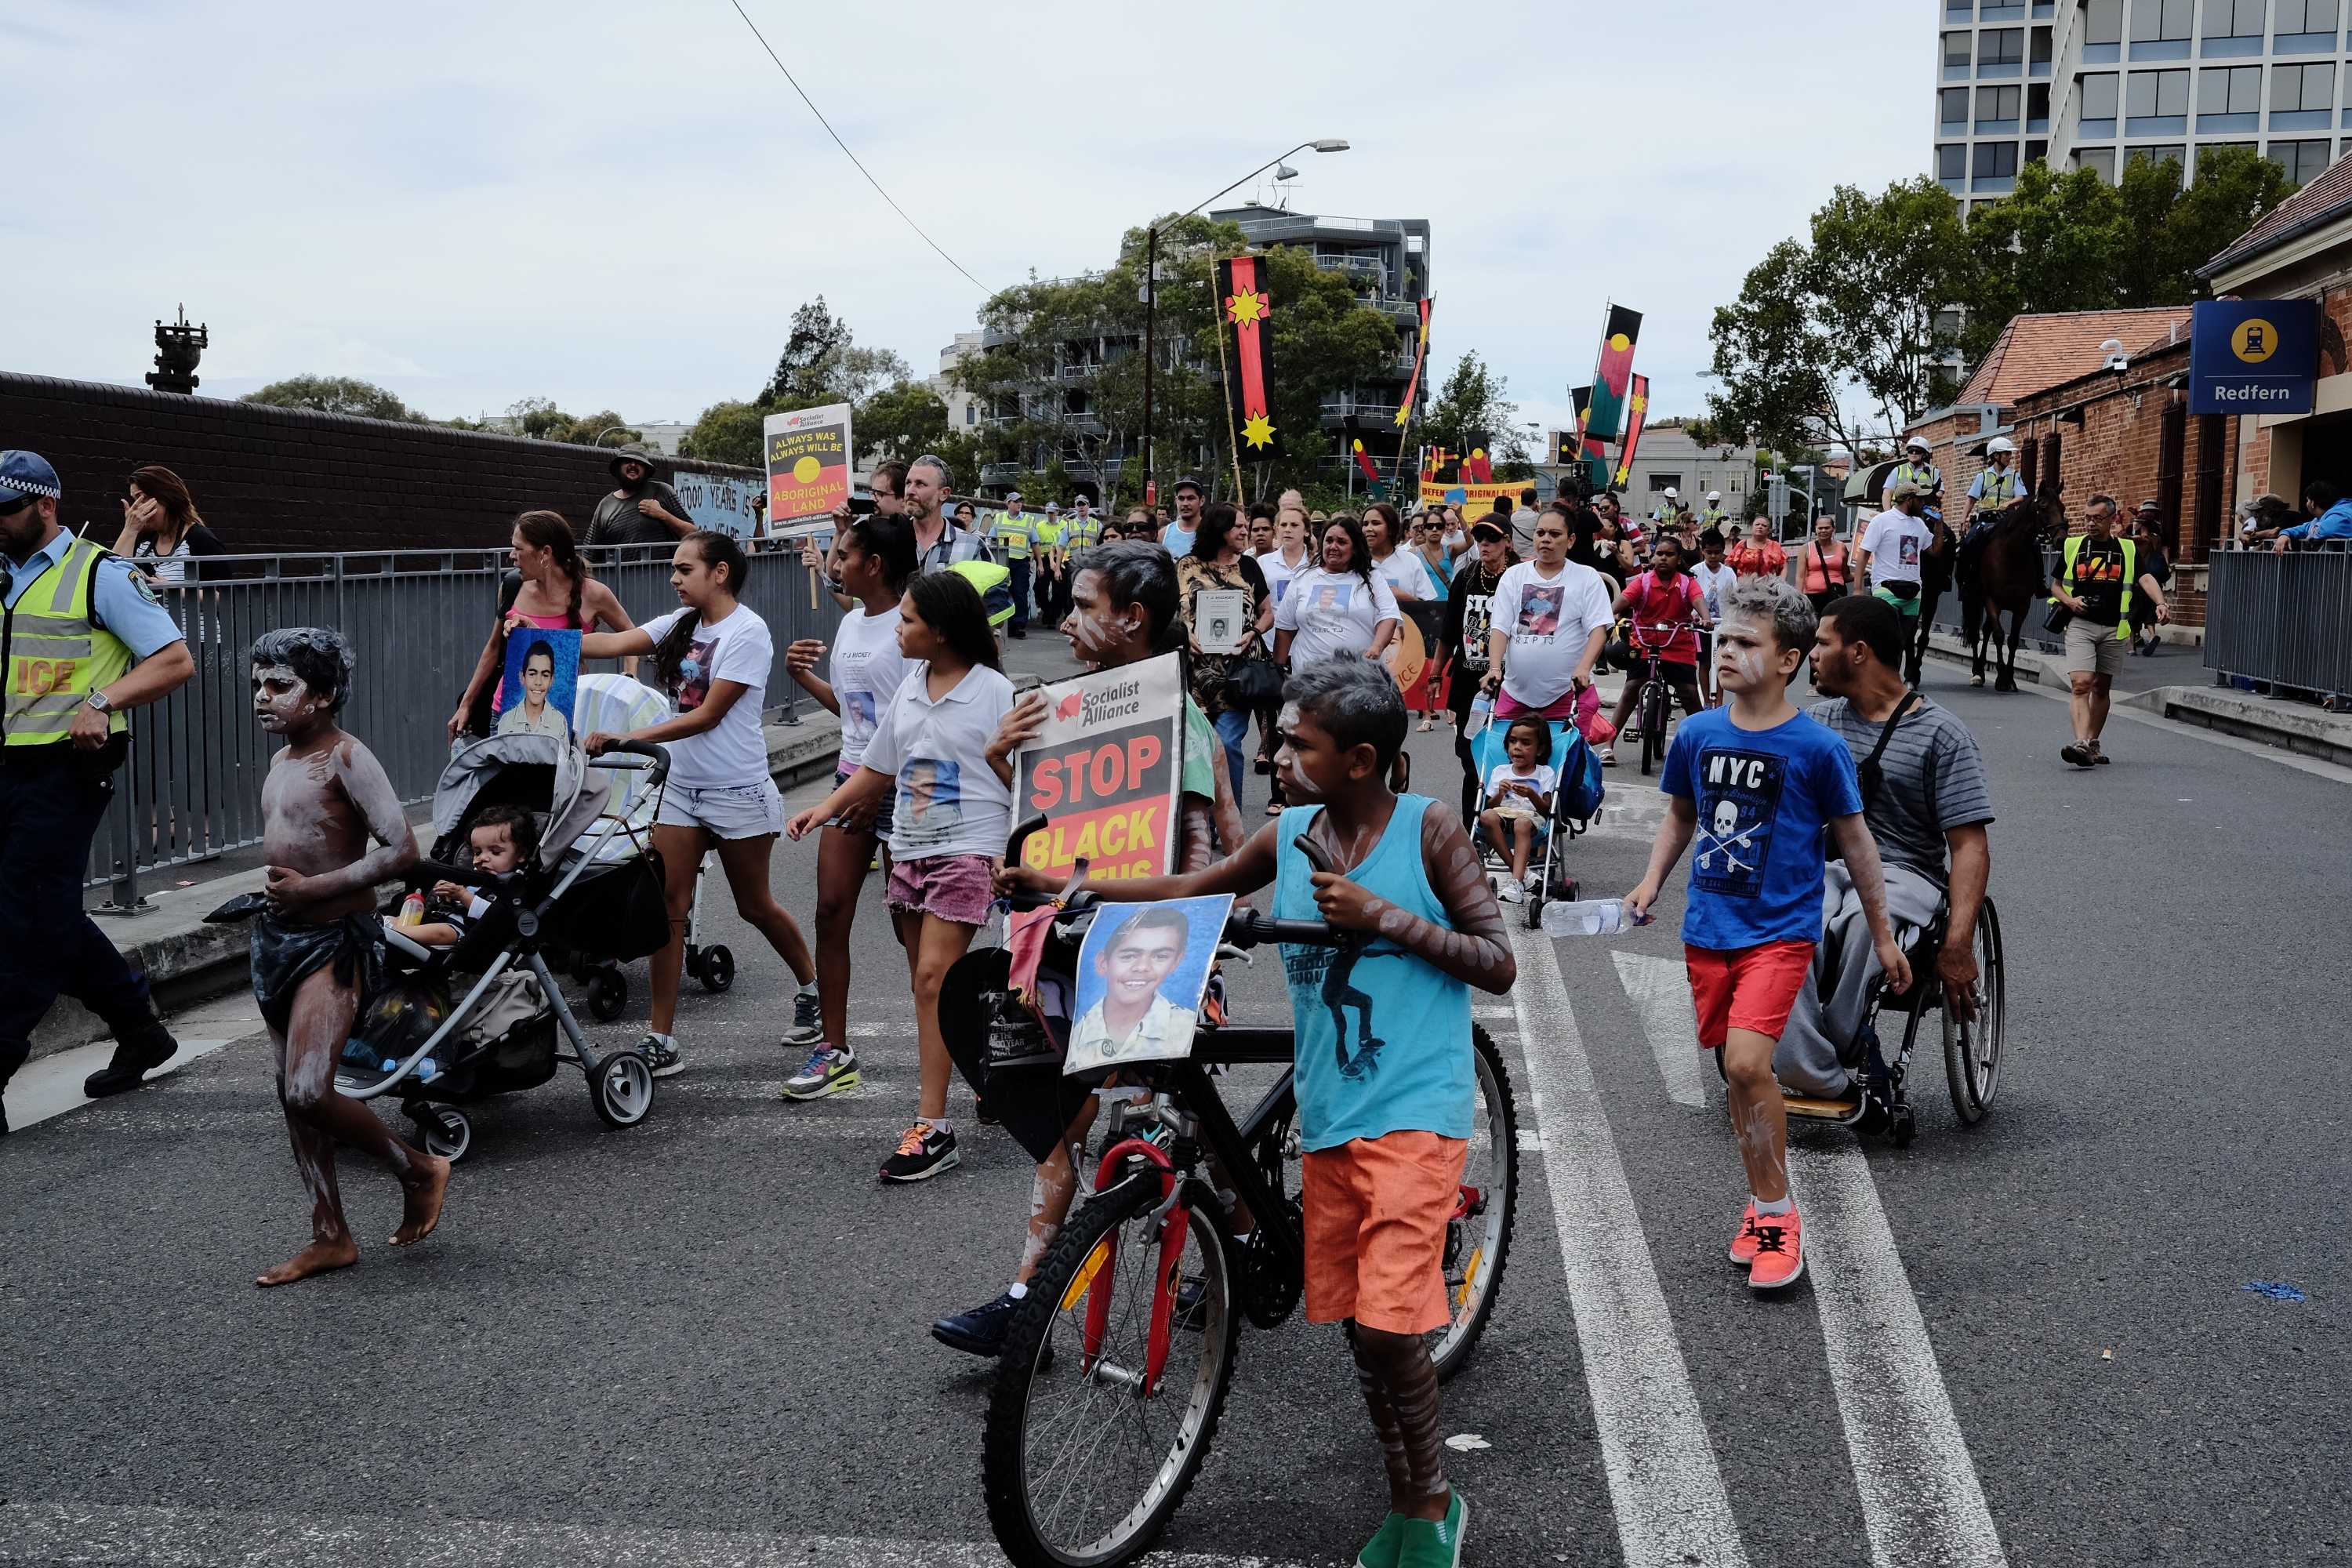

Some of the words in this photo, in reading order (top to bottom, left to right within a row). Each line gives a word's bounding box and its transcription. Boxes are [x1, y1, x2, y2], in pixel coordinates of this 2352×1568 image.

[2215, 385, 2289, 400] Redfern
[775, 434, 813, 450] ALWAYS
[815, 432, 836, 441] WAS
[771, 445, 804, 463] ALWAYS
[807, 444, 828, 452] WILL
[830, 443, 843, 452] BE
[774, 481, 844, 501] ABORIGINAL
[1422, 488, 1445, 497] DEFEN
[1465, 489, 1499, 498] ORIGINAL
[710, 485, 737, 511] YEARS
[742, 493, 750, 518] IS
[793, 499, 826, 514] LAND
[774, 514, 833, 526] www.socialist-allianc
[1466, 594, 1494, 612] STO
[1468, 615, 1490, 631] BLA
[1465, 626, 1491, 644] DEAT
[1398, 663, 1417, 687] ICE
[1082, 681, 1140, 711] Socialist
[1081, 701, 1139, 728] Alliance
[1030, 735, 1162, 810] STOP
[1708, 756, 1765, 789] NYC
[1025, 806, 1158, 871] BLACK
